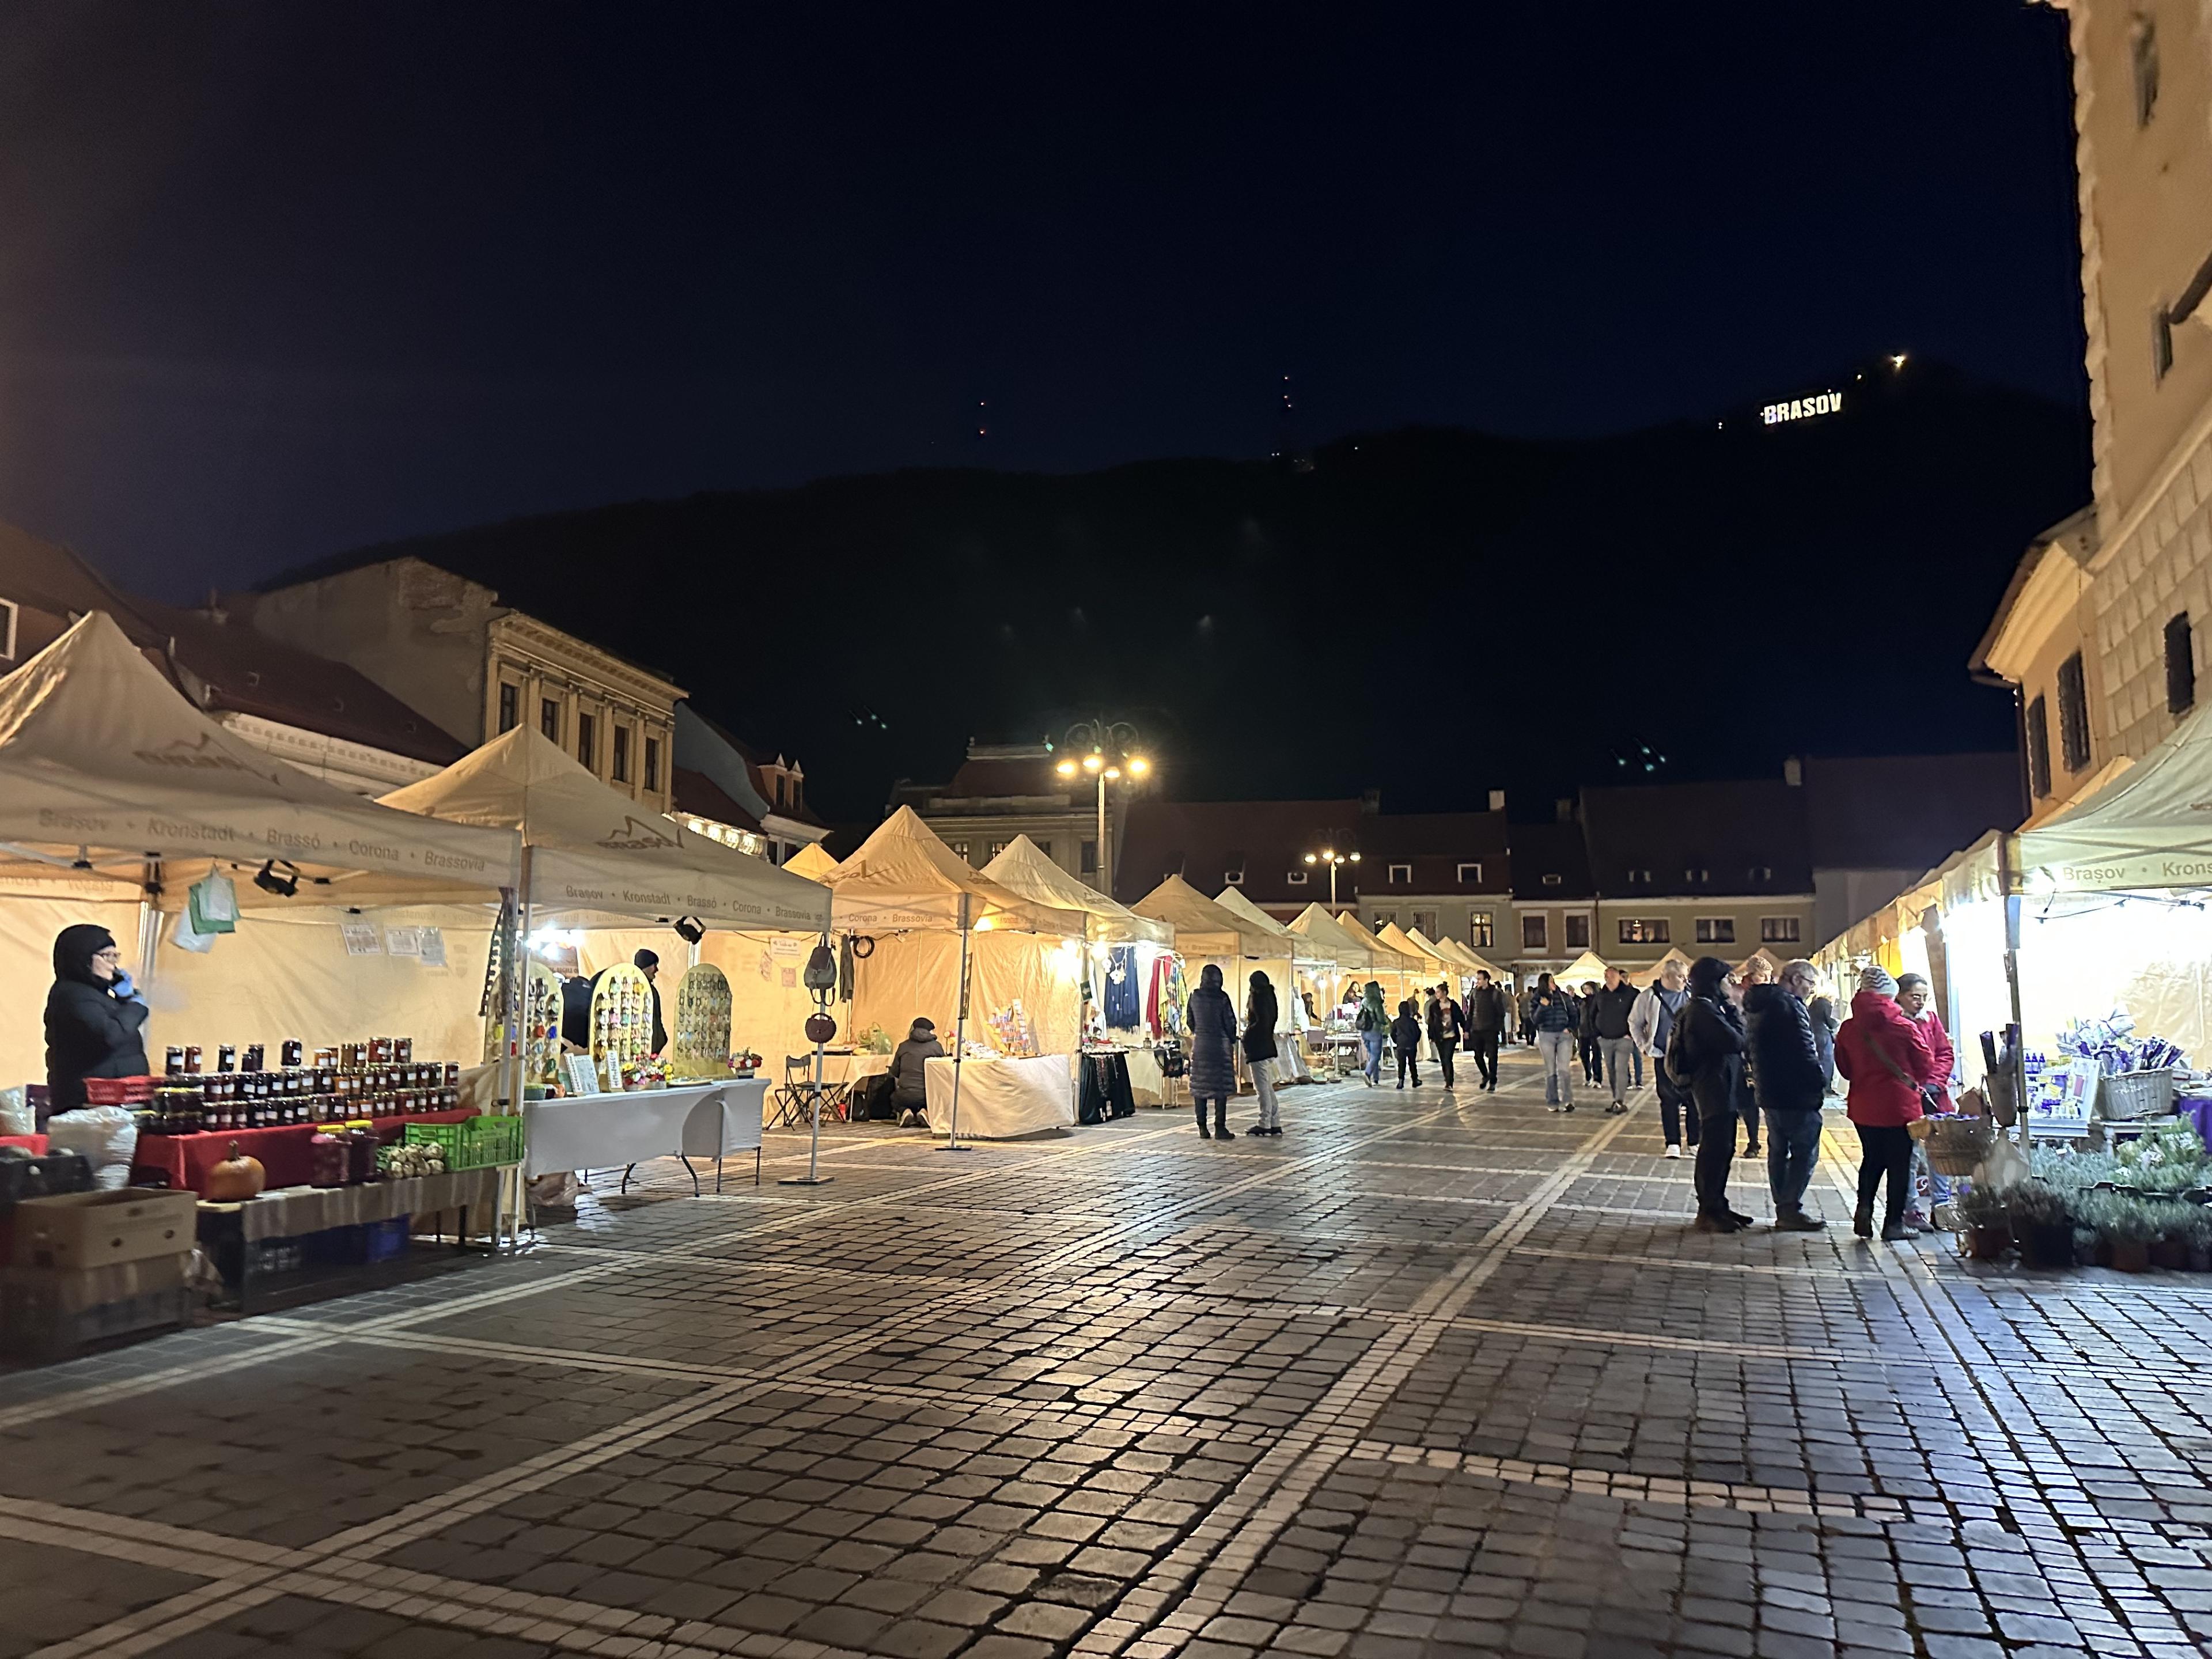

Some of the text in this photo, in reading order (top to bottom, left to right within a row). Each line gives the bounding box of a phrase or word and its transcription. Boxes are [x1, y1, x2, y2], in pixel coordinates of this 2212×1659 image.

[1763, 392, 1842, 425] BRASOV
[147, 817, 234, 841] Kronstadt
[267, 828, 320, 850] Brassó
[349, 840, 400, 861] Corona
[425, 851, 485, 872] Brassovia
[623, 889, 671, 905] Kronstadt
[687, 895, 717, 909] Brassó
[733, 900, 762, 915] Corona
[775, 906, 811, 921] Brassovia
[849, 913, 933, 922] Corona Brassovia
